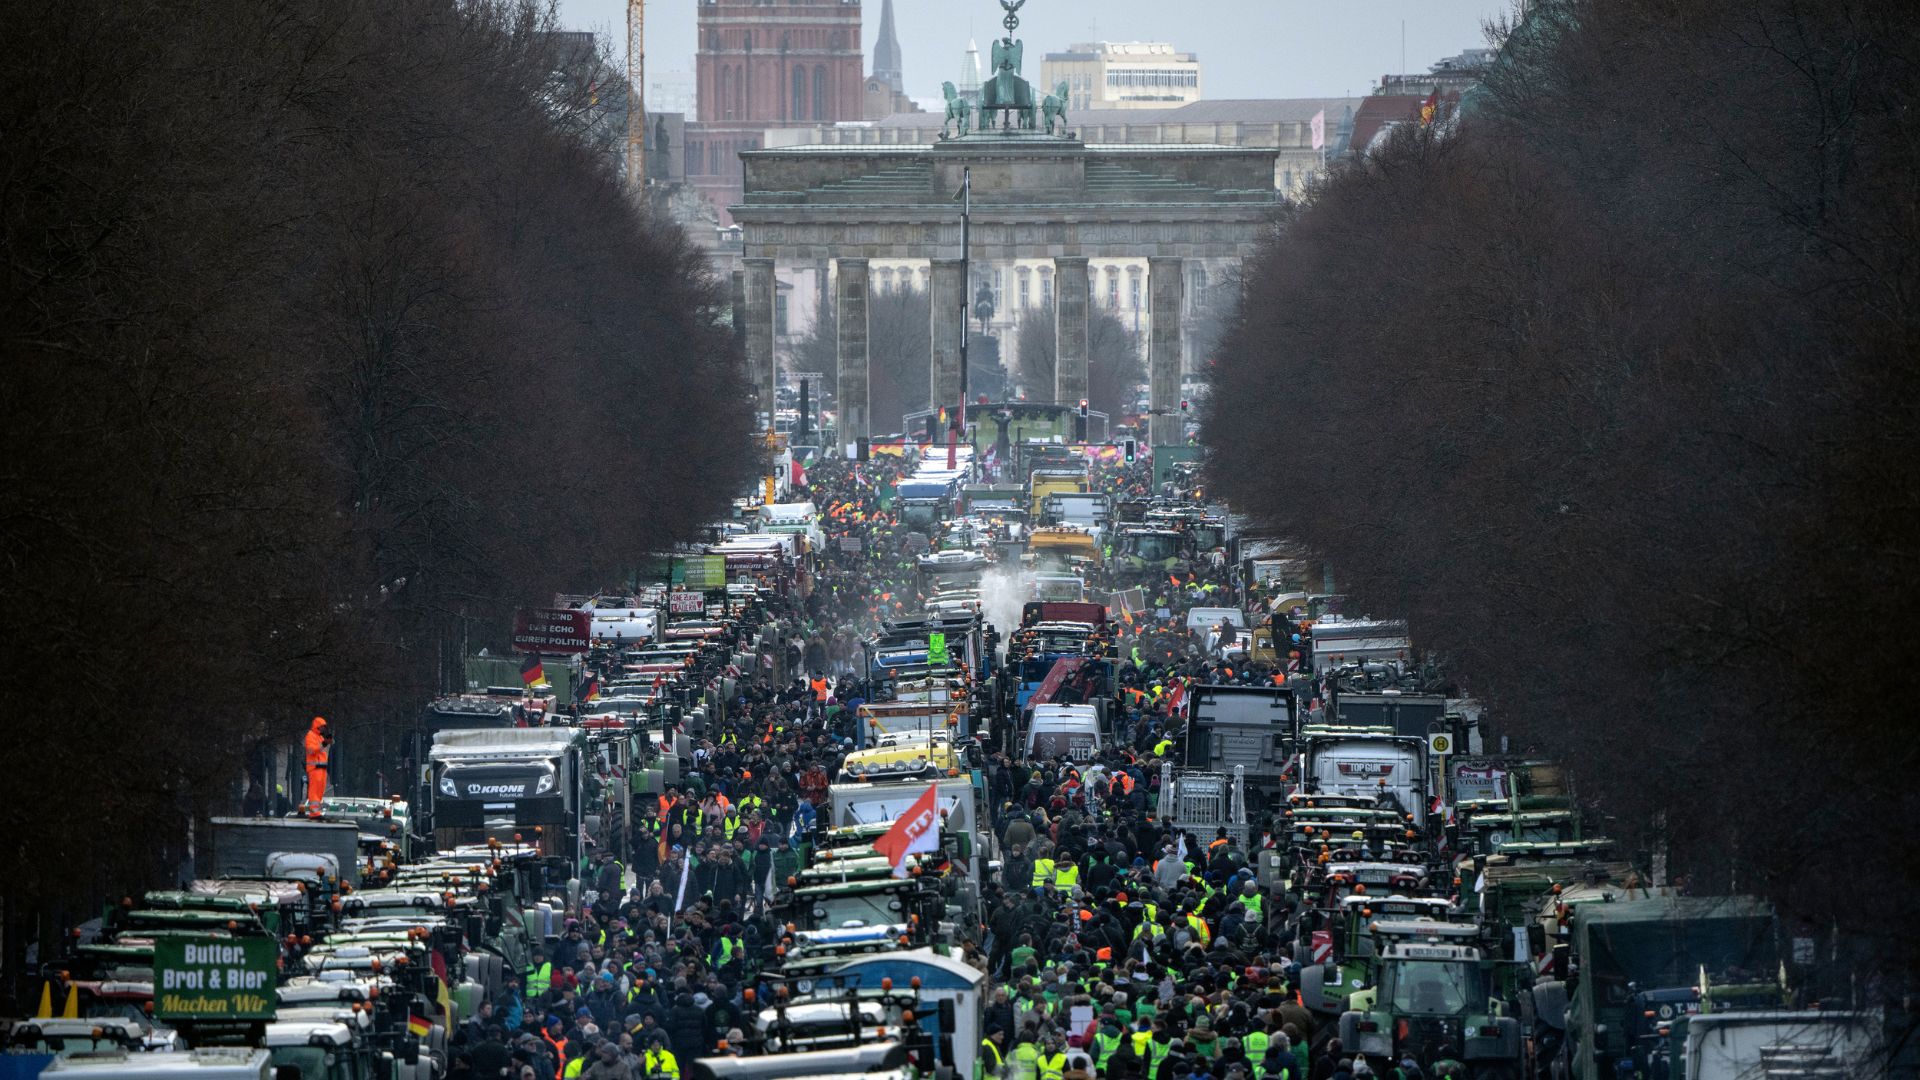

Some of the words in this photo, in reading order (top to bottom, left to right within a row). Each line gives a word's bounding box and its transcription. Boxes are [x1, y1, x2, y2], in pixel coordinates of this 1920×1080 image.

[549, 625, 574, 633] ECHO
[515, 635, 547, 644] EURER
[549, 637, 587, 646] POLITIK
[1351, 763, 1364, 772] TOP
[1365, 763, 1381, 772] GUN
[481, 784, 526, 794] KRONE
[163, 969, 204, 989] Brot
[208, 968, 222, 989] &
[227, 969, 267, 989] Bier
[162, 994, 228, 1013] Machen
[232, 994, 268, 1013] Wir
